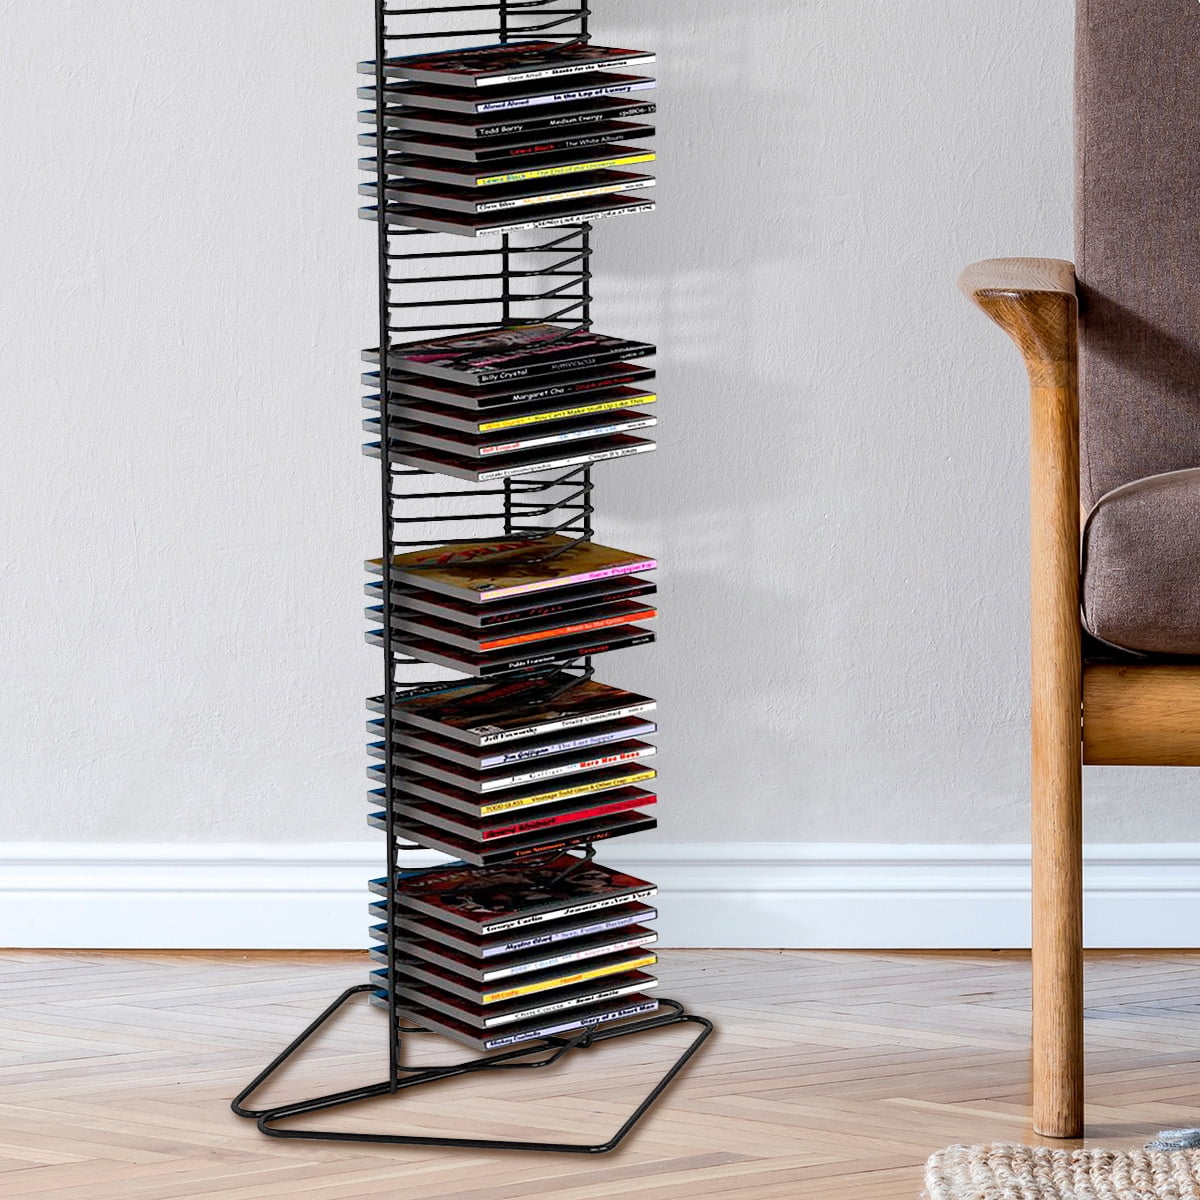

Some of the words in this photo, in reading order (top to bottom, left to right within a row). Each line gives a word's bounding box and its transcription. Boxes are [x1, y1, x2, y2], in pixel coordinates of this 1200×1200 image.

[501, 125, 523, 133] Barry
[578, 114, 603, 122] Energy
[500, 369, 528, 379] Crystal
[512, 390, 548, 400] Margaret
